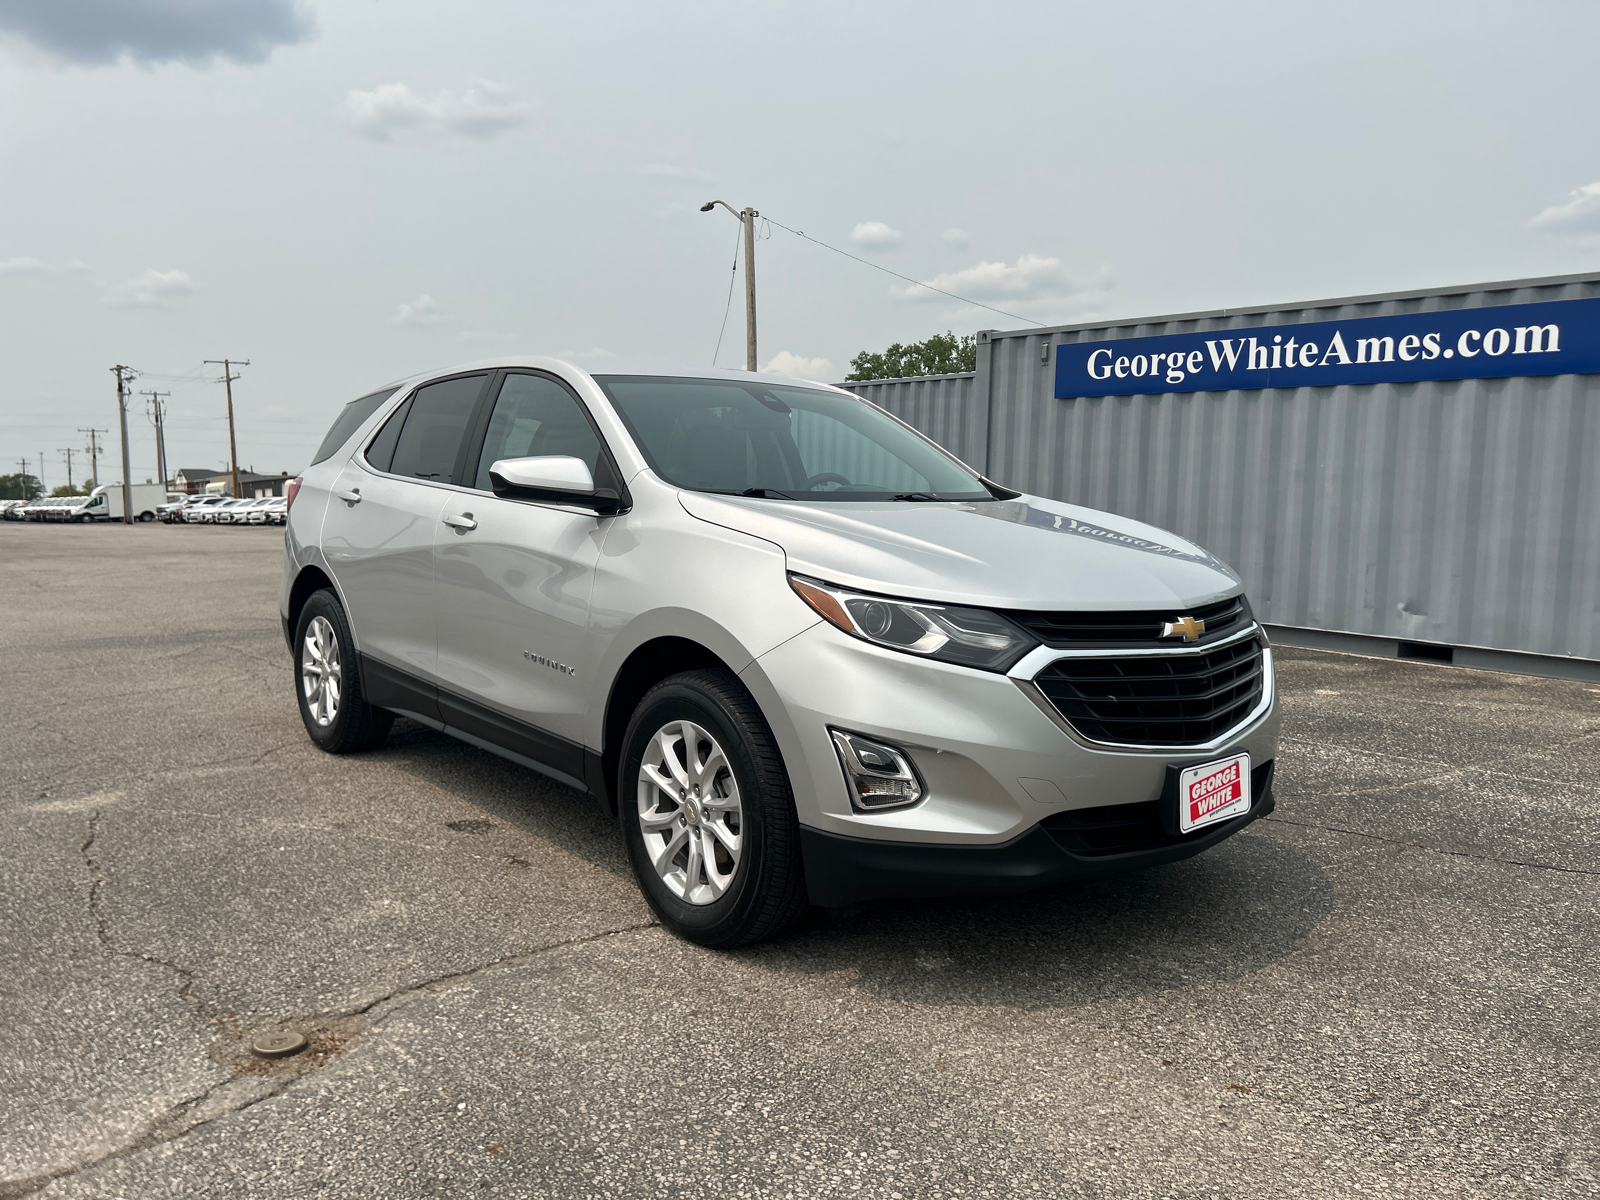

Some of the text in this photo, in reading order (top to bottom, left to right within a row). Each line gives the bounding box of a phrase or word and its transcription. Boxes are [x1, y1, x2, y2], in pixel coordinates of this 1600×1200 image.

[1086, 322, 1562, 385] GeorgeWhiteAmes.com
[523, 651, 576, 677] EQUINOX
[1191, 765, 1236, 799] GEORGE
[1197, 785, 1232, 816] WHITE
